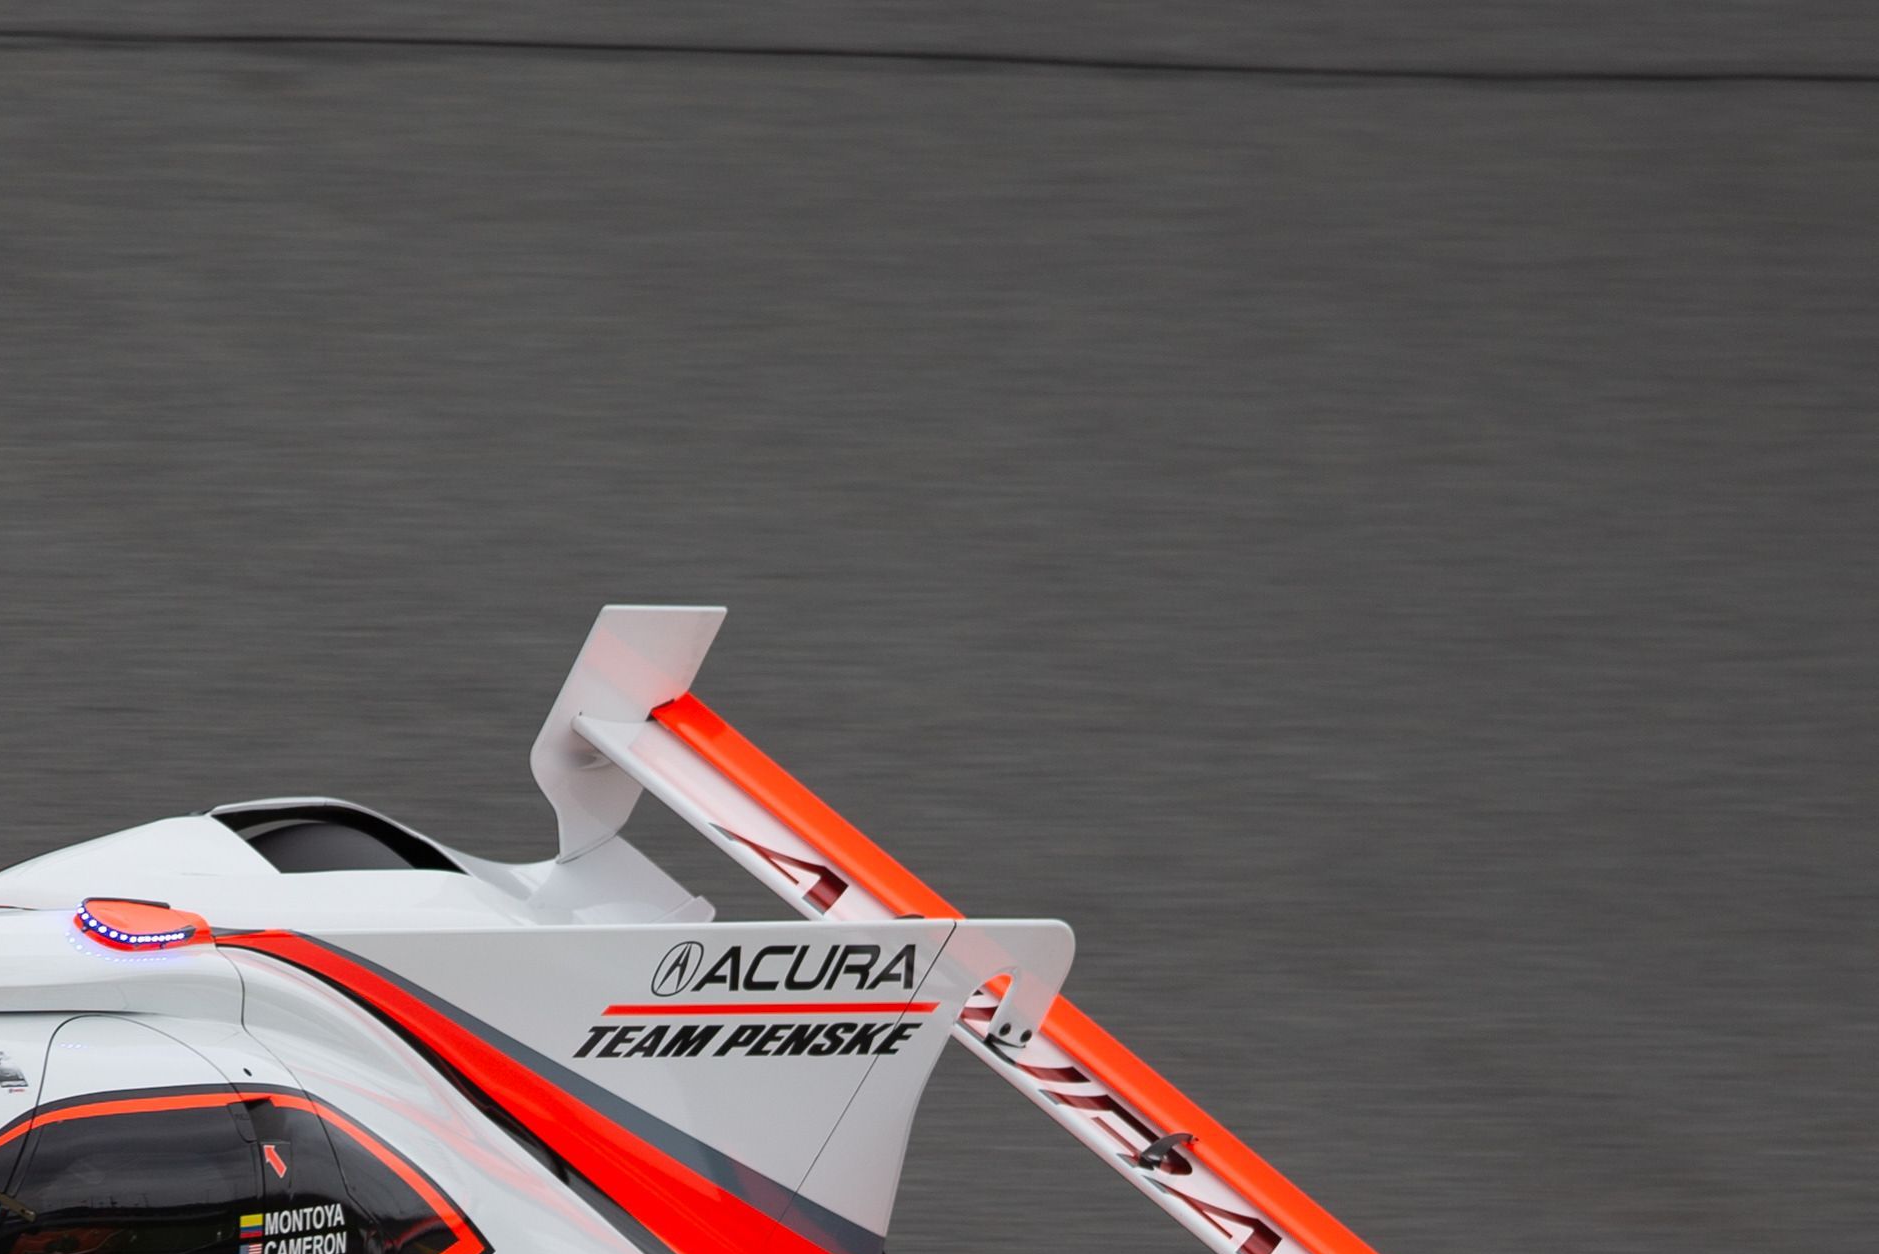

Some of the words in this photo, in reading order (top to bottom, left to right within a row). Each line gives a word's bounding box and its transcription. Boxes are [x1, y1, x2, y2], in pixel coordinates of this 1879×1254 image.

[690, 944, 917, 992] ACURA
[572, 1024, 725, 1058] TEAM
[712, 1022, 924, 1057] PENSKE
[264, 1203, 345, 1236] MONTOYA
